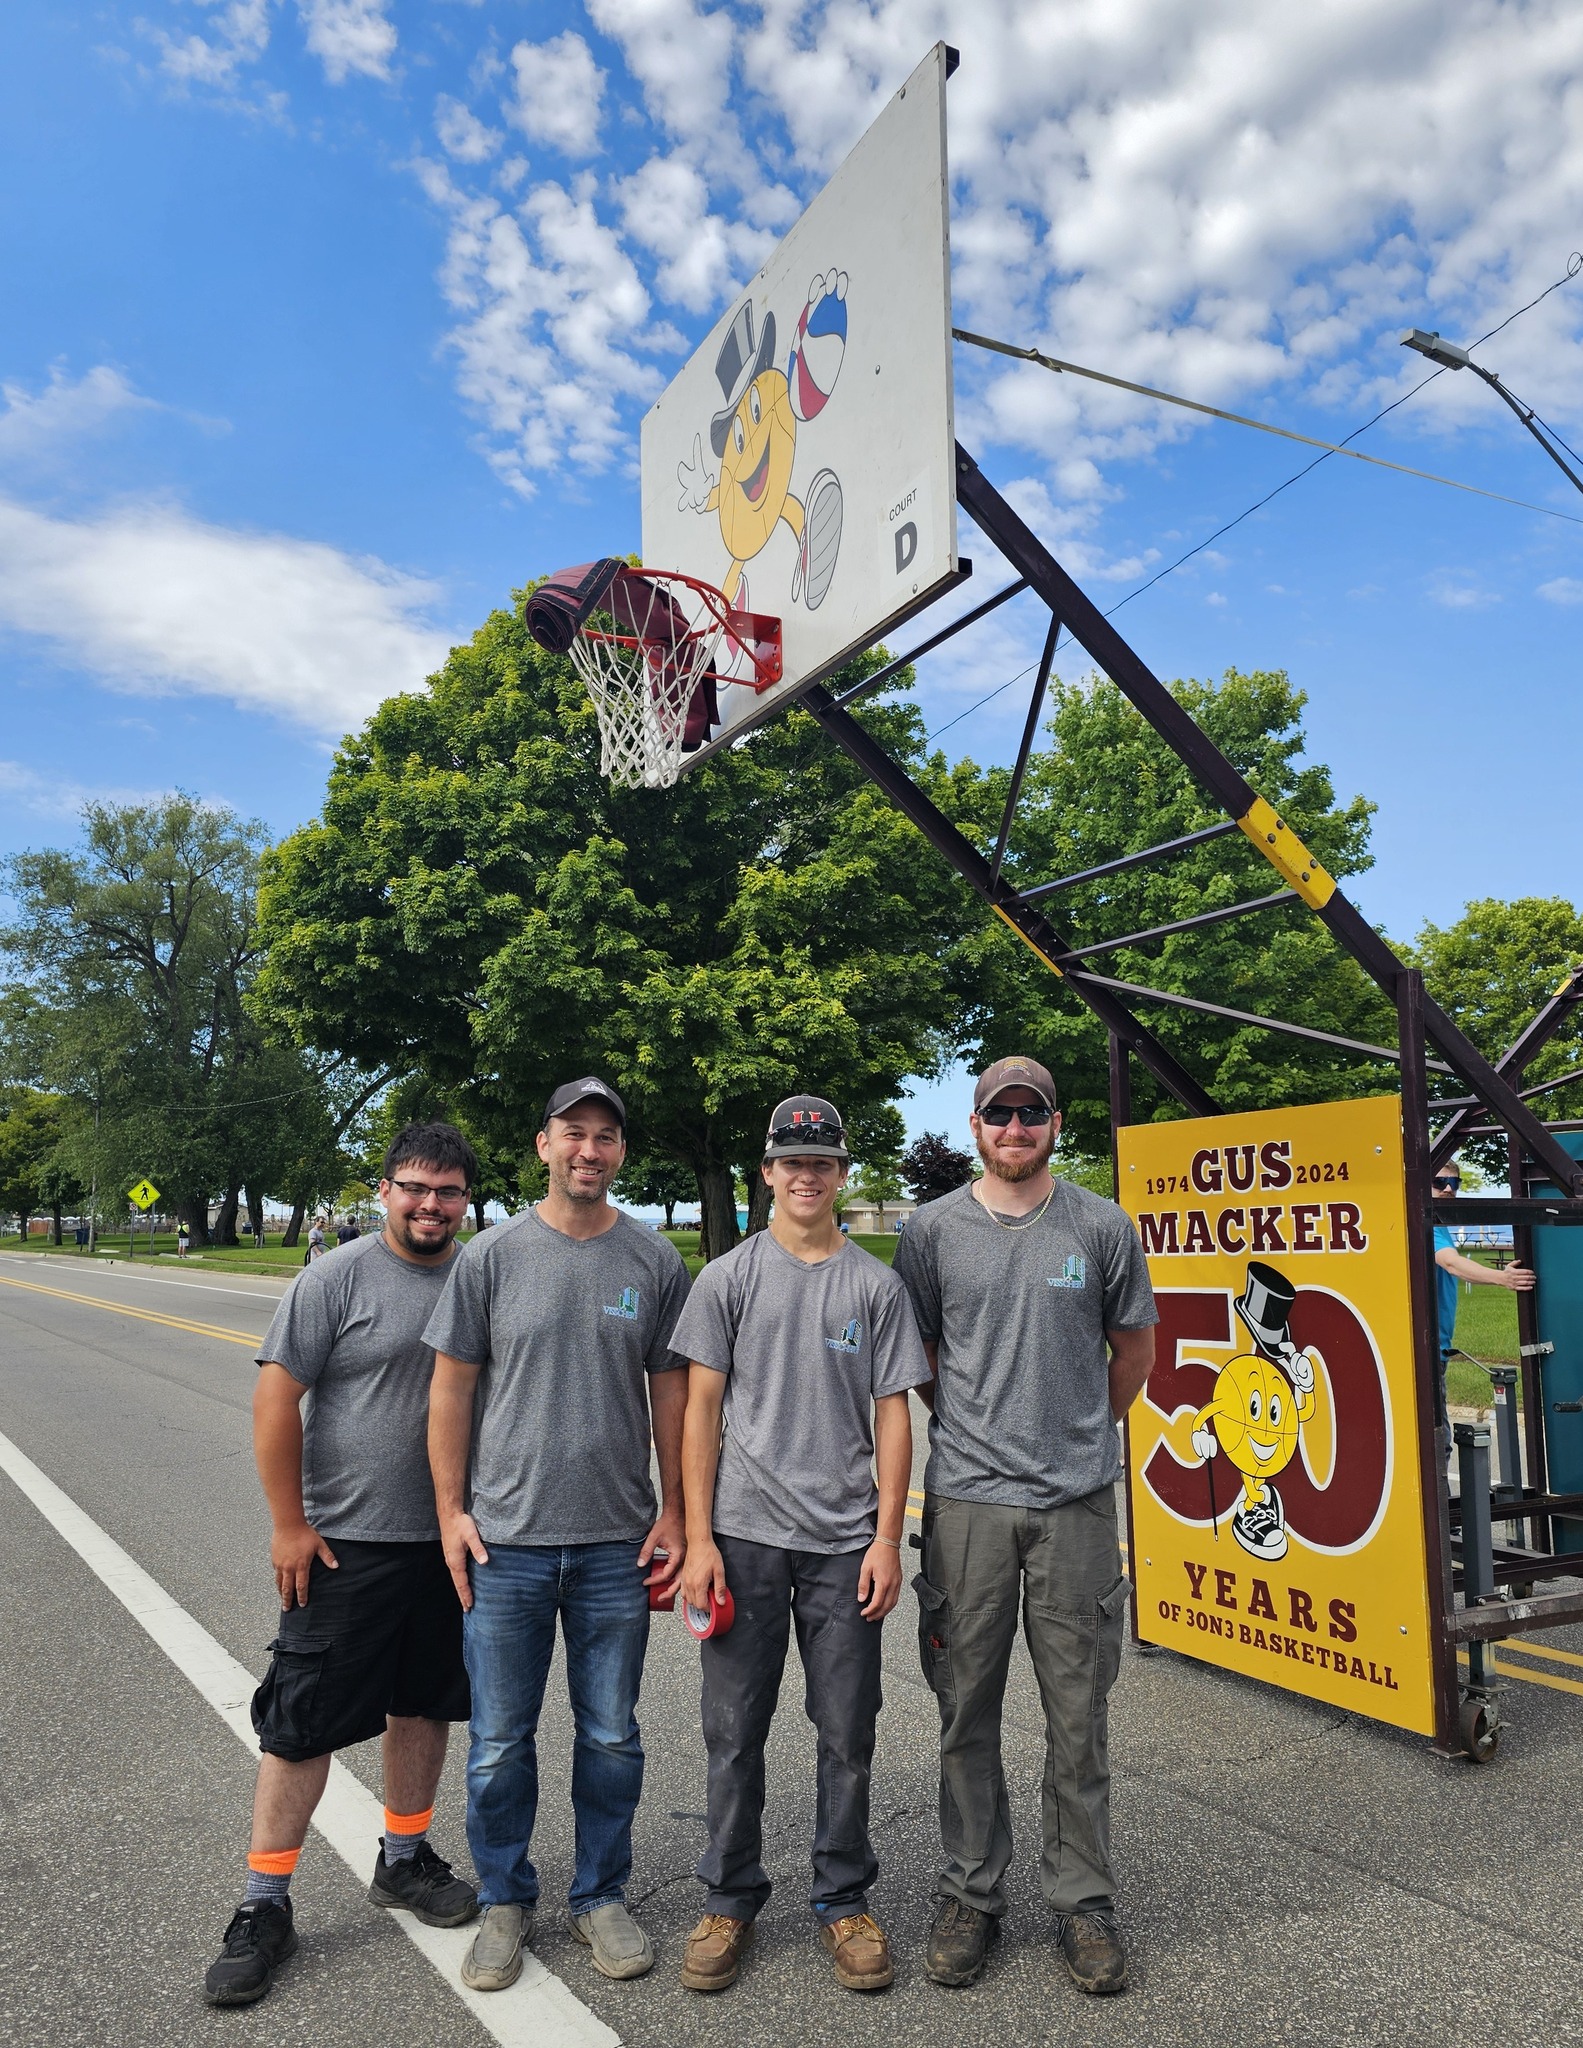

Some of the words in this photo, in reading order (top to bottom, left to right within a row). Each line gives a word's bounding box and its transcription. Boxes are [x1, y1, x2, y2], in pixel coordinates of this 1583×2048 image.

[889, 488, 917, 521] COURT
[895, 521, 918, 575] D
[1146, 1175, 1189, 1195] 1974
[1191, 1140, 1292, 1195] GUS
[1296, 1162, 1349, 1184] 2024
[1137, 1201, 1369, 1257] MACKER
[1140, 1286, 1394, 1556] 50
[1184, 1561, 1358, 1643] YEARS
[1158, 1600, 1181, 1622] OF
[1239, 1623, 1399, 1690] BASKETBALL
